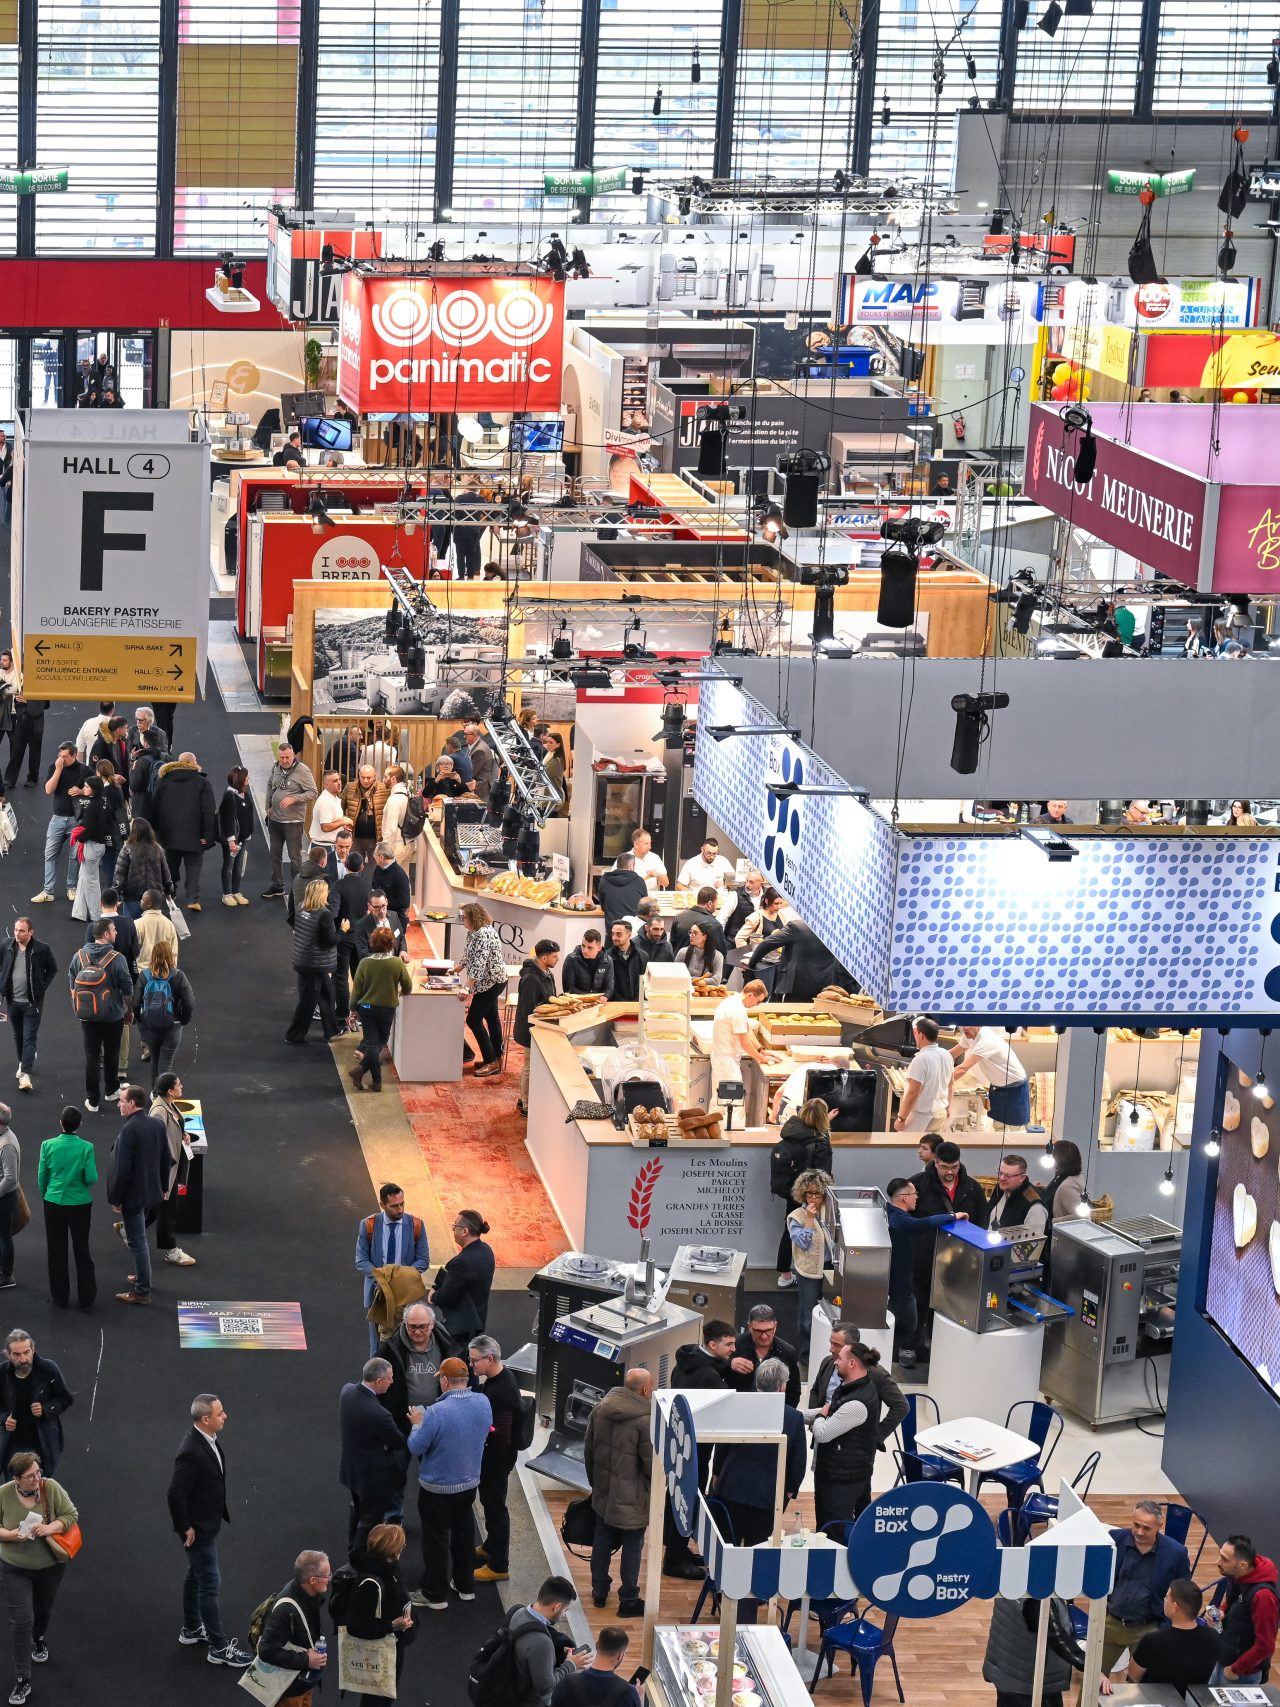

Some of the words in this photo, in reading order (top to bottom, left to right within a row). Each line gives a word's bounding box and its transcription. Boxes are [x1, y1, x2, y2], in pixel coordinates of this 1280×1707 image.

[31, 173, 59, 183] SORTIE
[553, 175, 583, 185] SORTIE
[28, 185, 36, 193] DE
[36, 183, 62, 192] SECOURS
[550, 186, 558, 194] DE
[559, 186, 587, 195] SECOURS
[862, 283, 939, 303] MAP
[1192, 306, 1234, 314] CUISSN
[369, 351, 552, 390] panimatic
[729, 420, 759, 428] Tranchge
[770, 420, 785, 428] pain
[63, 457, 121, 475] HALL
[142, 459, 155, 474] 4
[1101, 474, 1195, 551] MEUNERIE
[80, 490, 155, 592] F
[322, 557, 330, 568] I
[321, 571, 371, 580] BREAD
[63, 606, 111, 616] BAKERY
[114, 607, 160, 617] PASTRY
[40, 616, 118, 628] BOULANGERIE
[121, 617, 183, 629] PÂTISSERIE
[691, 1159, 706, 1167] Les
[709, 1158, 748, 1167] Moulins
[682, 1171, 715, 1179] JOSEPH
[666, 1203, 709, 1211] GRANDES
[711, 1211, 745, 1219] GRASSE
[660, 1228, 693, 1236] JOSEPH
[408, 1363, 437, 1374] FILA
[875, 1506, 909, 1517] Baker
[874, 1519, 908, 1533] Box
[936, 1574, 970, 1584] Pastry
[936, 1586, 969, 1600] Box
